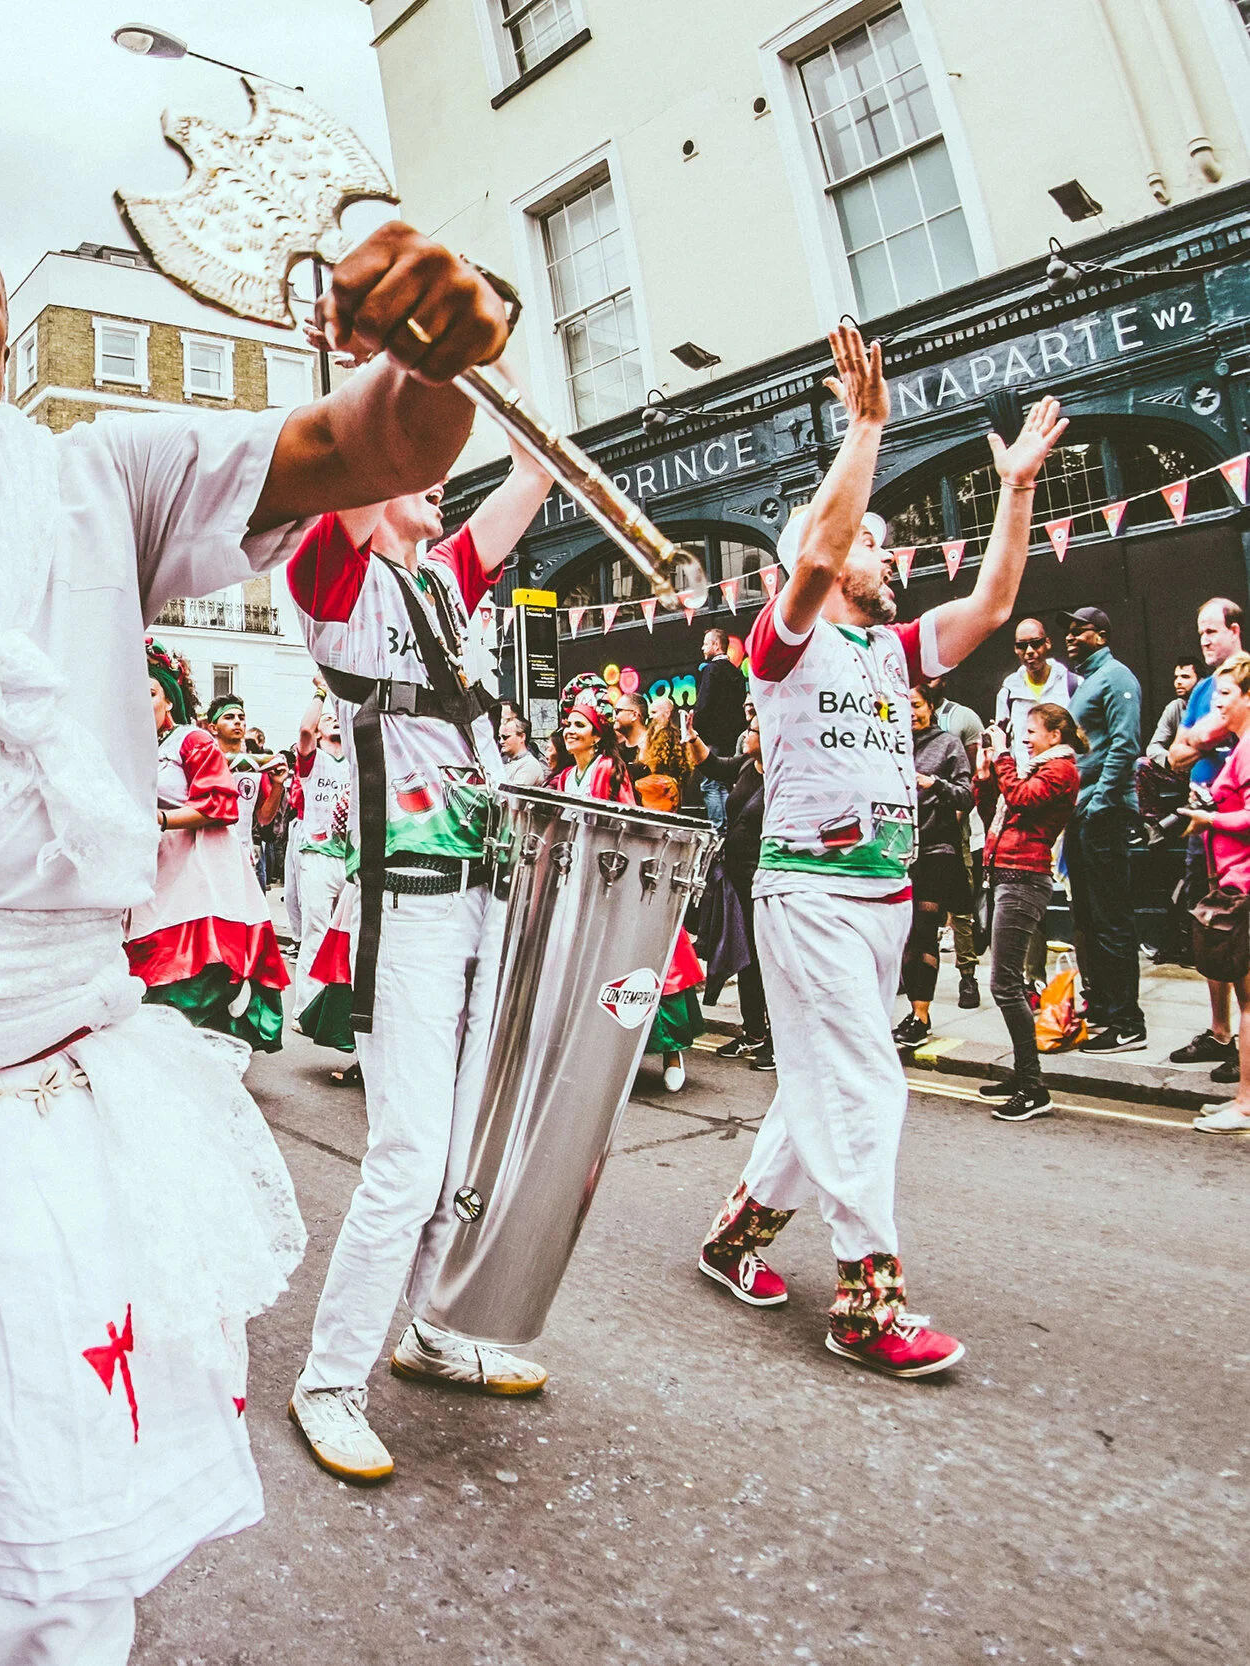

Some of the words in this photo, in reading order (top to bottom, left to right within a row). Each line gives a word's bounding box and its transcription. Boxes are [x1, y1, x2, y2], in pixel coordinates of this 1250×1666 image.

[542, 493, 578, 526] TH
[611, 431, 757, 498] PRINCE
[828, 307, 1145, 438] BNAPARTE
[1150, 301, 1196, 331] W2
[819, 726, 856, 749] de
